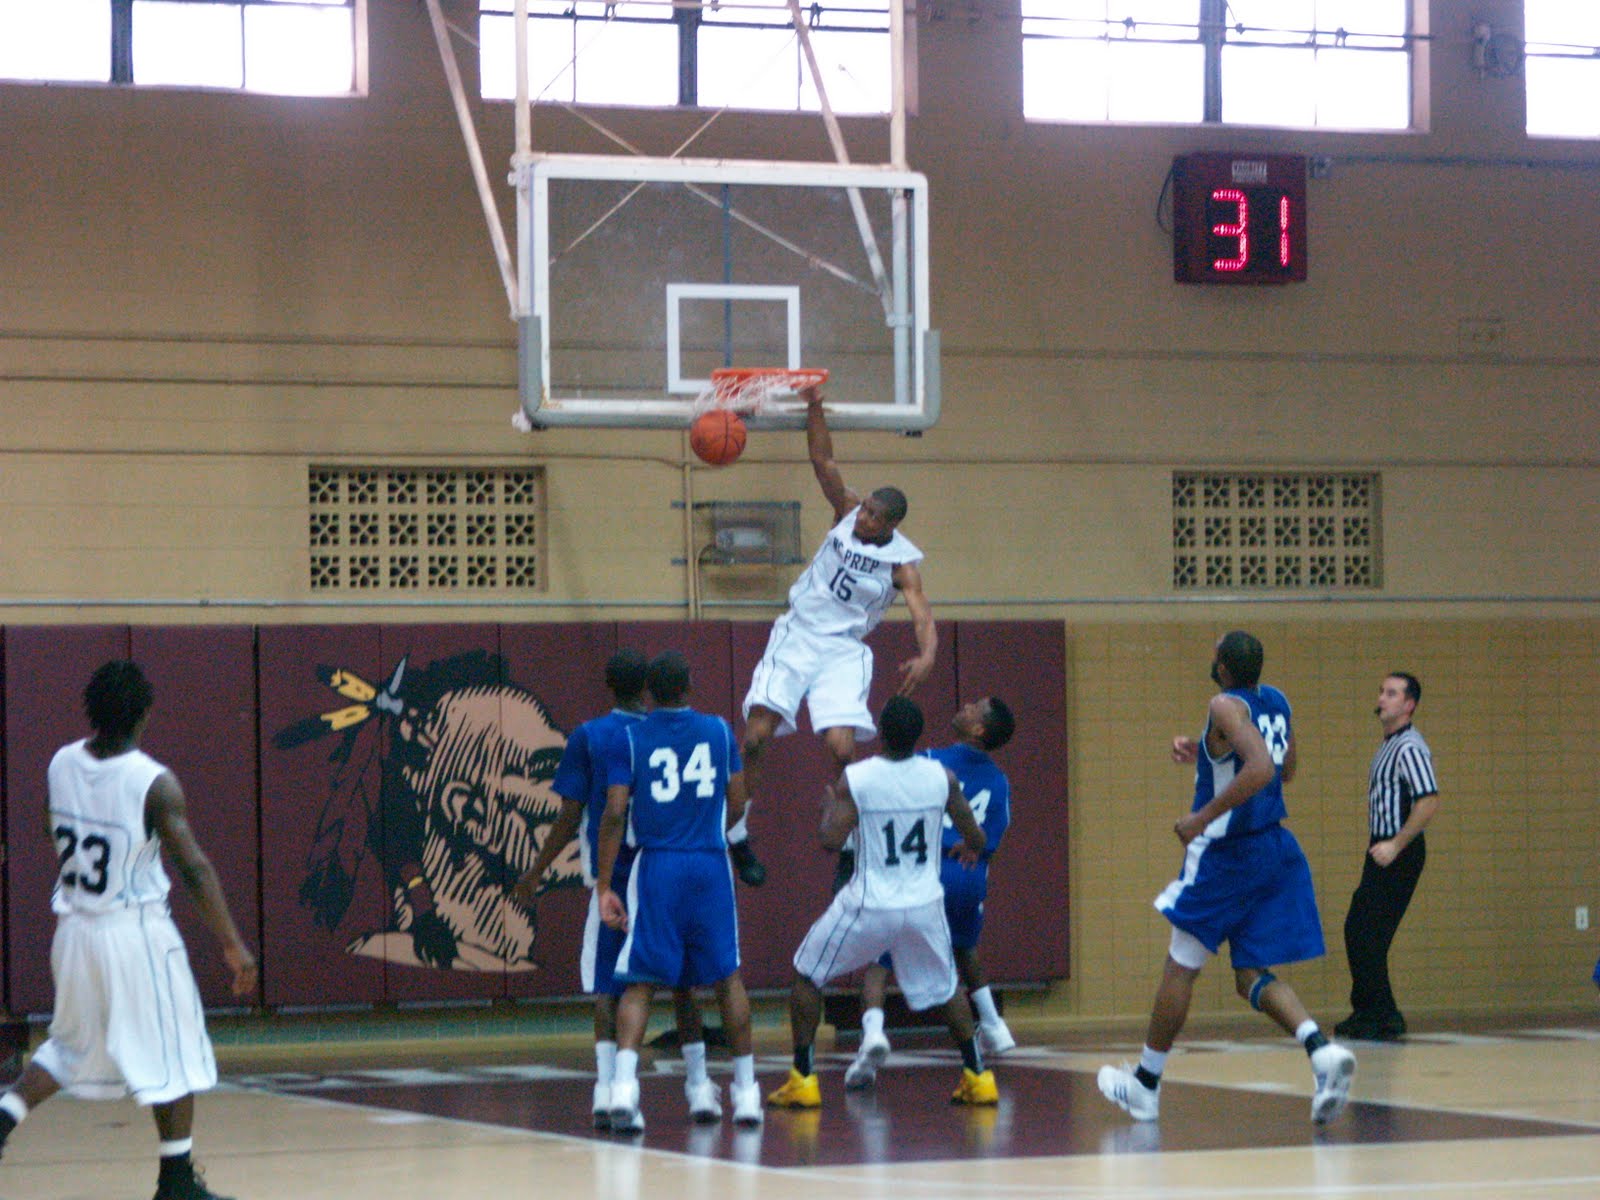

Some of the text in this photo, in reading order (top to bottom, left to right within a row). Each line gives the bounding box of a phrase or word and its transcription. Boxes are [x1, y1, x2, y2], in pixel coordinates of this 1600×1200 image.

[1212, 188, 1291, 272] 31
[829, 567, 857, 602] 15
[844, 549, 880, 574] PREP
[648, 742, 717, 803] 34
[55, 825, 111, 896] 23
[881, 817, 928, 866] 14
